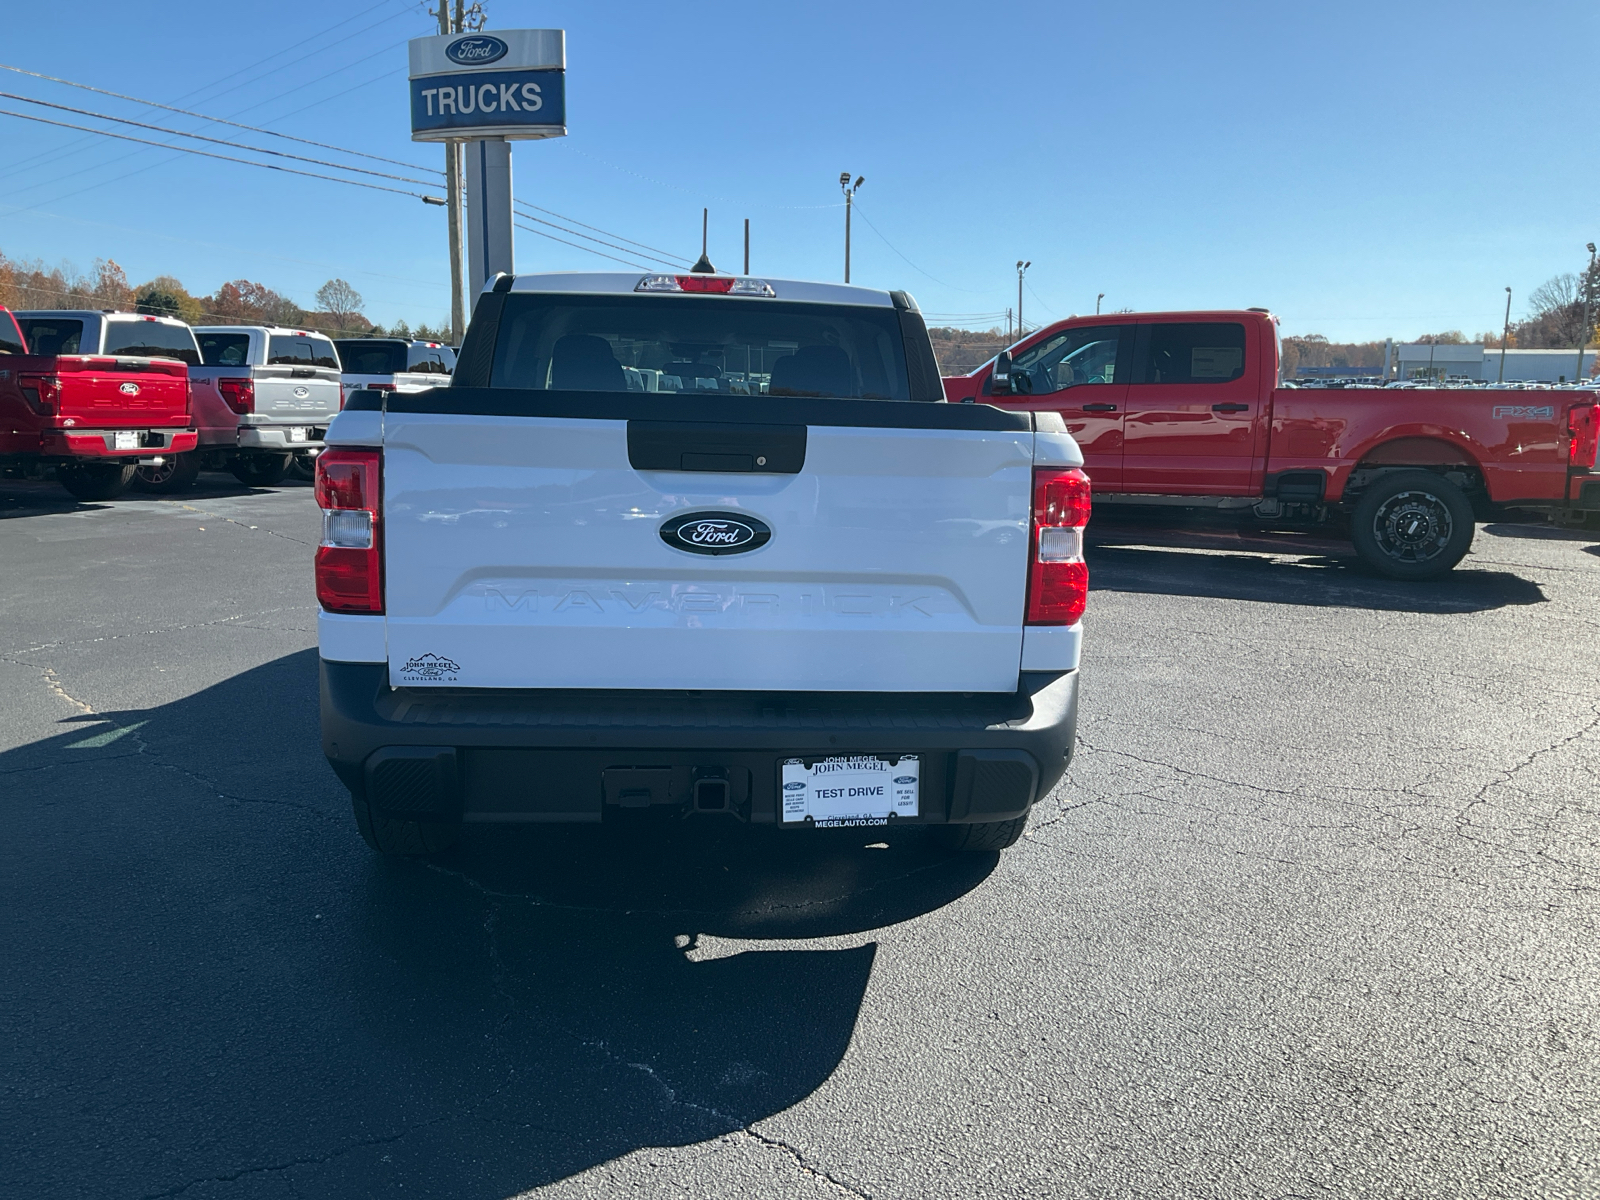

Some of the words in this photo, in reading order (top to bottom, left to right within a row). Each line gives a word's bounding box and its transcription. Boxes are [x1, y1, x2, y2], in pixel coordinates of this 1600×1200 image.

[457, 40, 492, 59] Ford
[421, 83, 543, 117] TRUCKS
[1492, 405, 1554, 420] FX4
[692, 522, 740, 543] Ford
[484, 588, 933, 618] MAVERICK
[813, 763, 844, 776] JOHN
[846, 761, 887, 772] MEGEL
[815, 788, 845, 799] TEST
[848, 786, 884, 797] DRIVE
[815, 818, 888, 829] MEGELAUTO.COM
